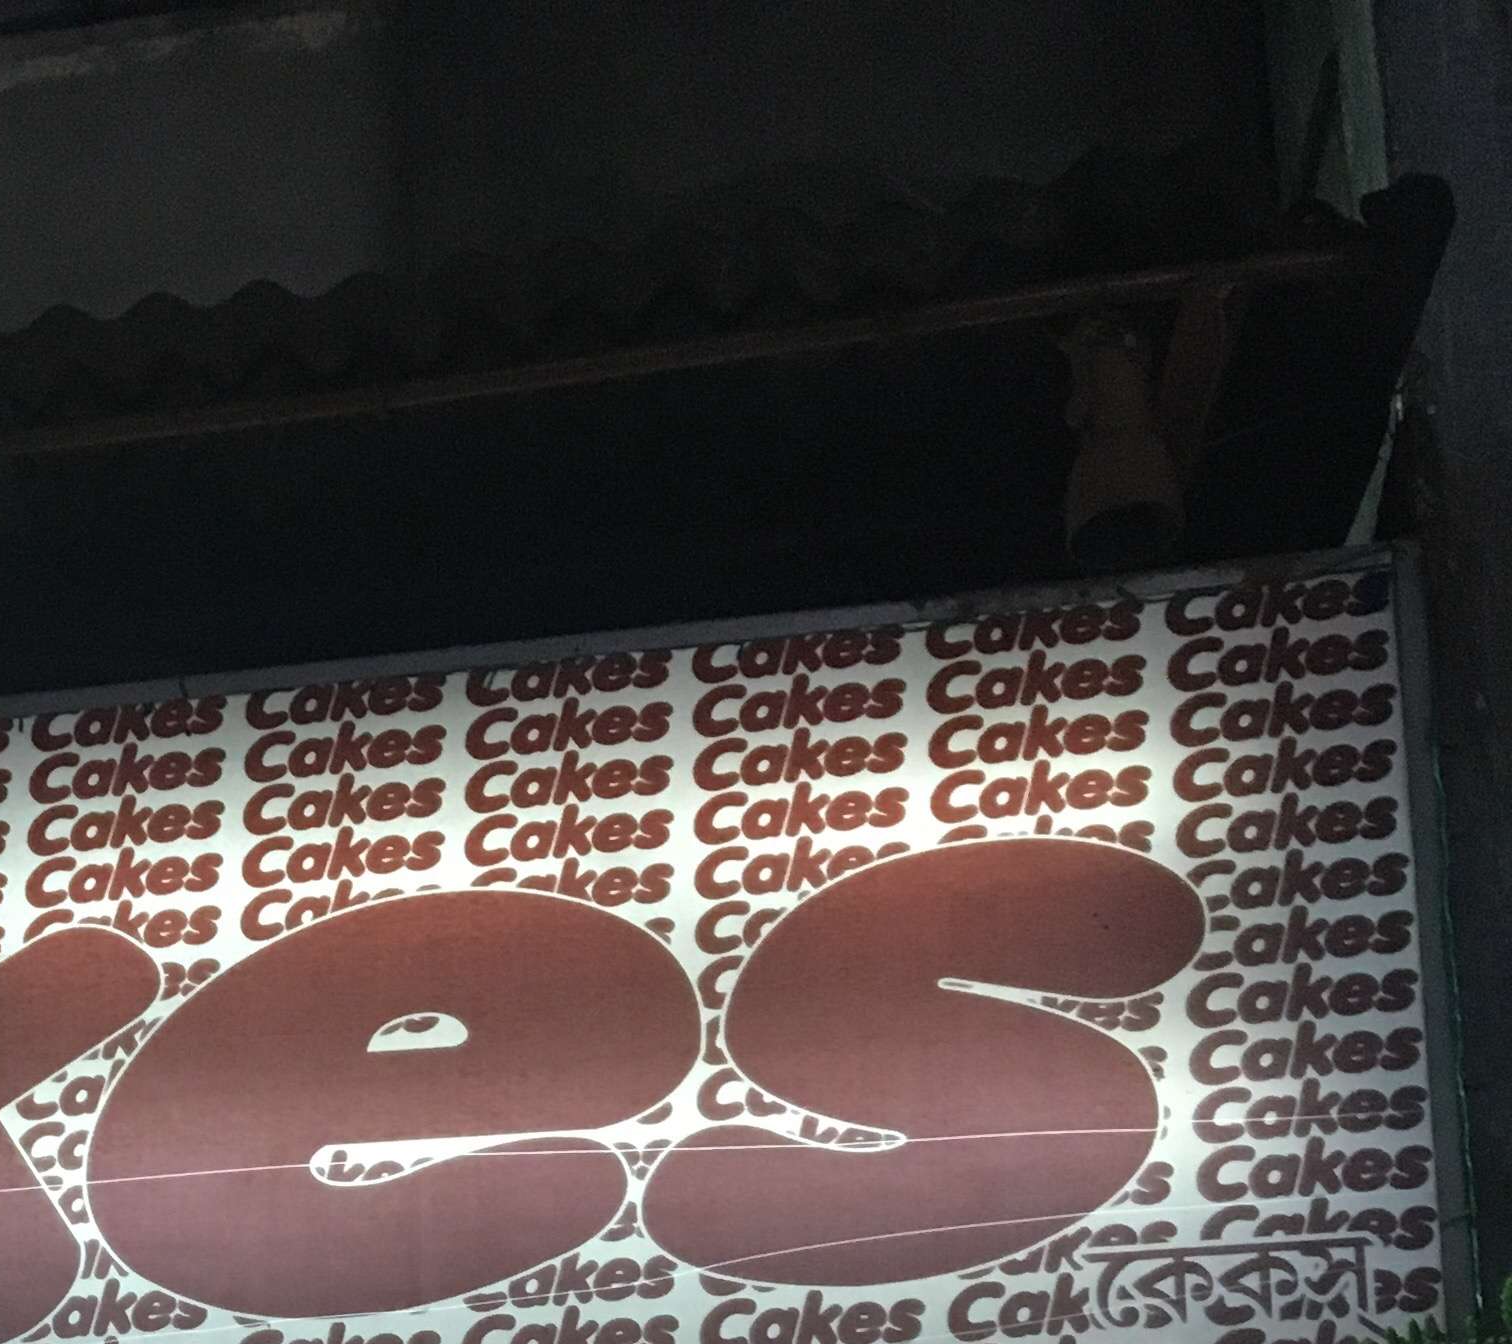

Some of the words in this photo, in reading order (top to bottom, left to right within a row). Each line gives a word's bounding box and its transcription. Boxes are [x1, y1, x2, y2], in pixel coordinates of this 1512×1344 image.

[29, 742, 226, 804] Cakes
[244, 720, 446, 783] Cakes
[464, 697, 672, 760] Cakes
[692, 673, 906, 737] Cakes
[925, 649, 1146, 714] Cakes
[1166, 624, 1394, 692] Cakes
[27, 794, 224, 856] Cakes
[242, 772, 445, 835] Cakes
[464, 750, 673, 813] Cakes
[692, 727, 907, 791] Cakes
[928, 704, 1148, 769] Cakes
[1169, 679, 1398, 747] Cakes
[25, 847, 222, 908] Cakes
[242, 826, 444, 887] Cakes
[464, 804, 673, 866] Cakes
[693, 781, 908, 844] Cakes
[930, 760, 1150, 823] Cakes
[1172, 735, 1402, 803] Cakes
[1175, 791, 1406, 859] Cakes
[1184, 962, 1418, 1030] Cakes
[1187, 1019, 1422, 1088] Cakes
[1190, 1077, 1426, 1147] Cakes
[1194, 1136, 1430, 1205] Cakes
